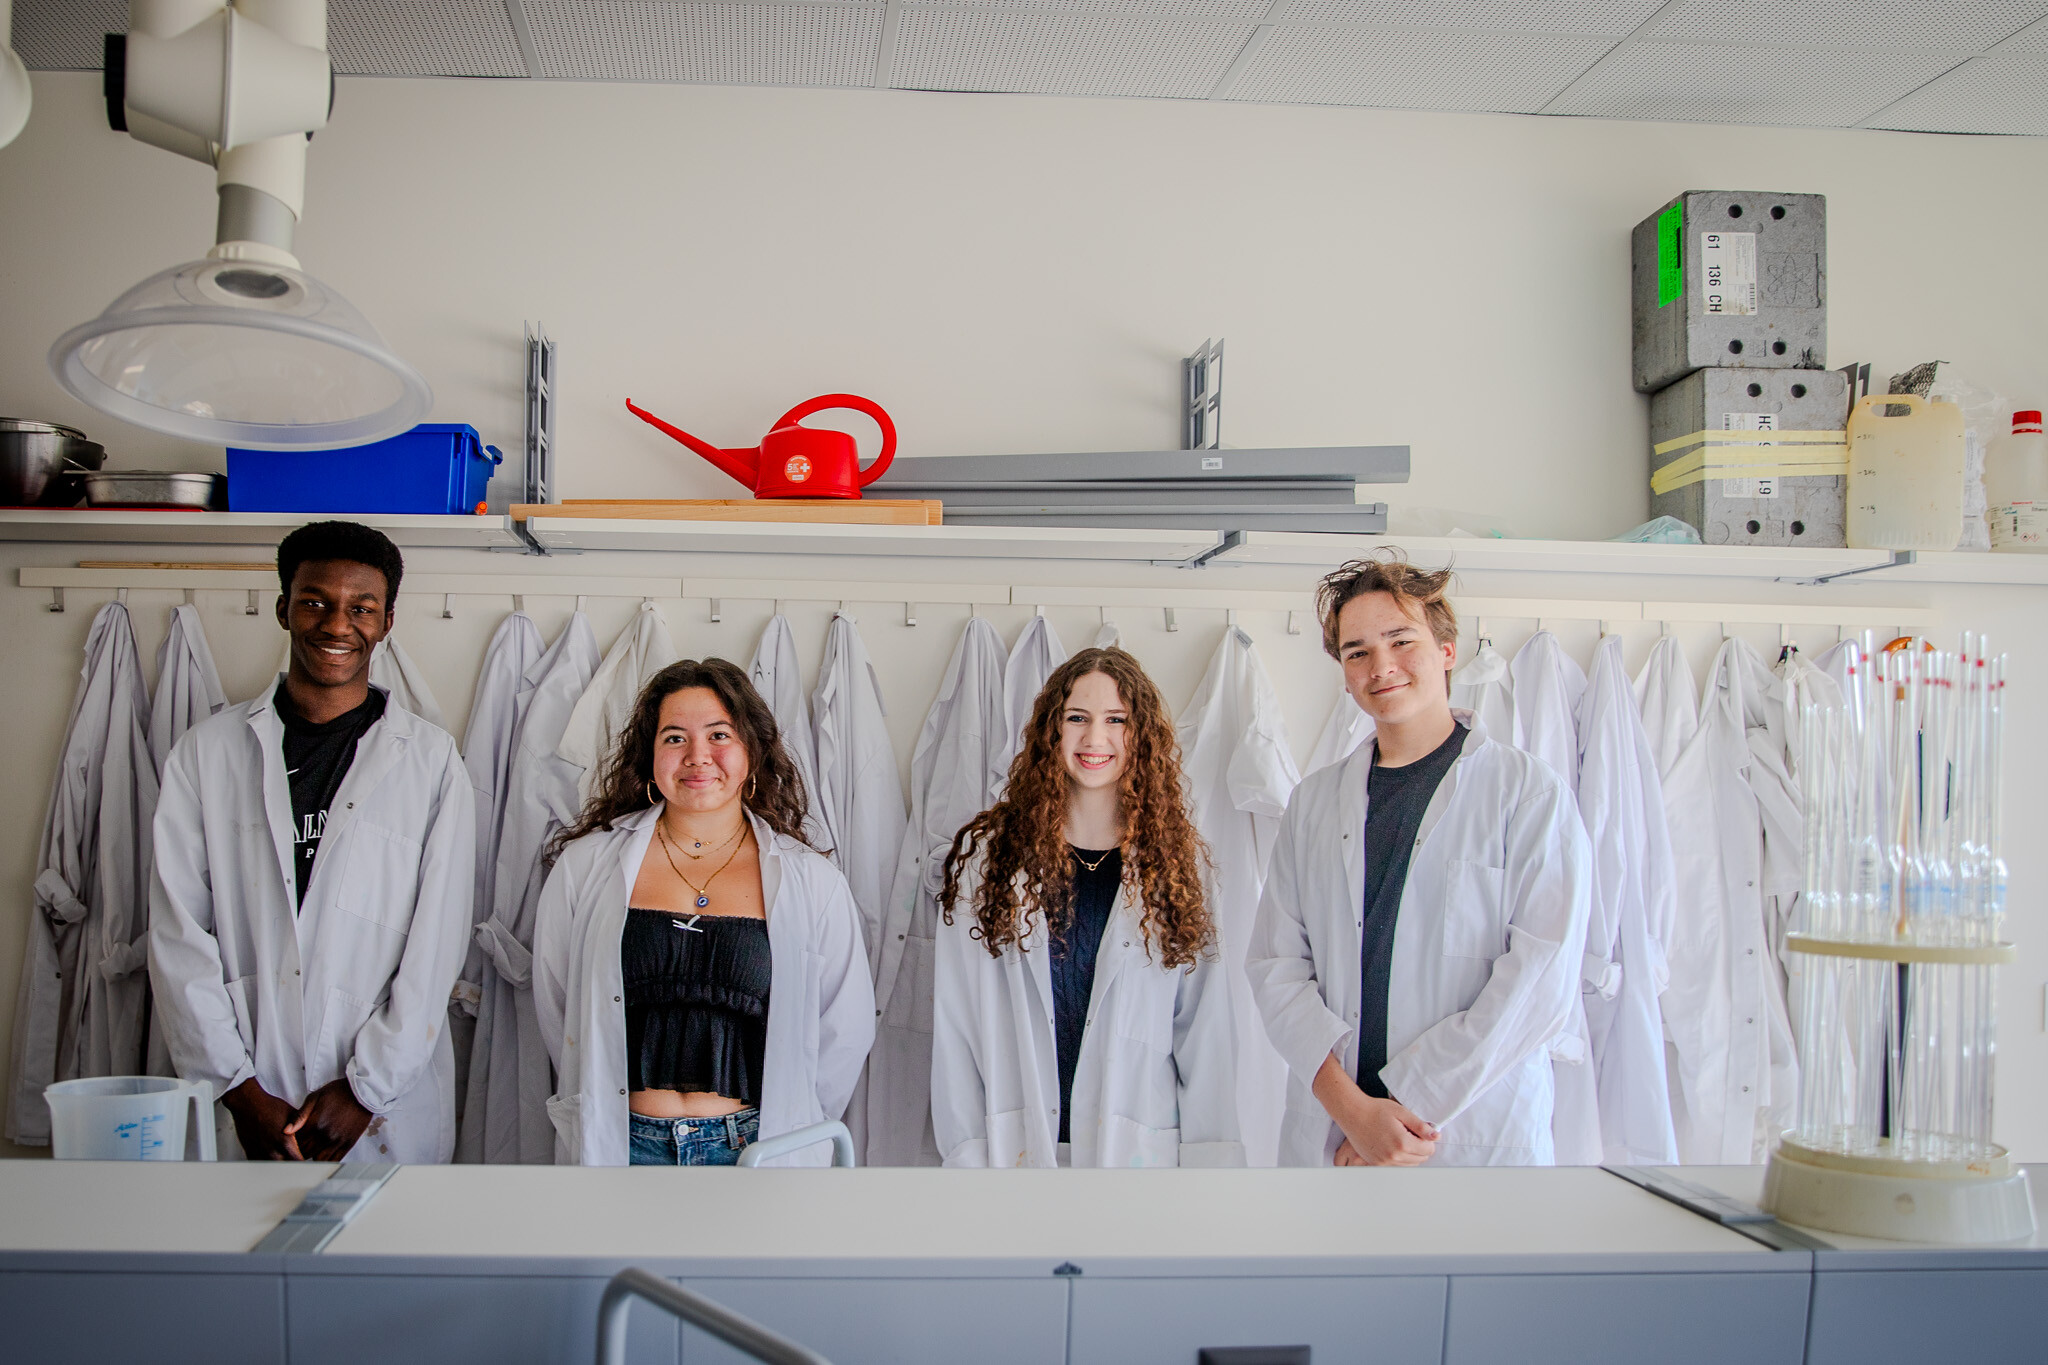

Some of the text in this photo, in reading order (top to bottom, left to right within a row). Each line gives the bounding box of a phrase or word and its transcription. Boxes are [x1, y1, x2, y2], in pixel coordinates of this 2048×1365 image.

[1707, 234, 1722, 312] 61 136 CH
[1759, 480, 1771, 495] 61
